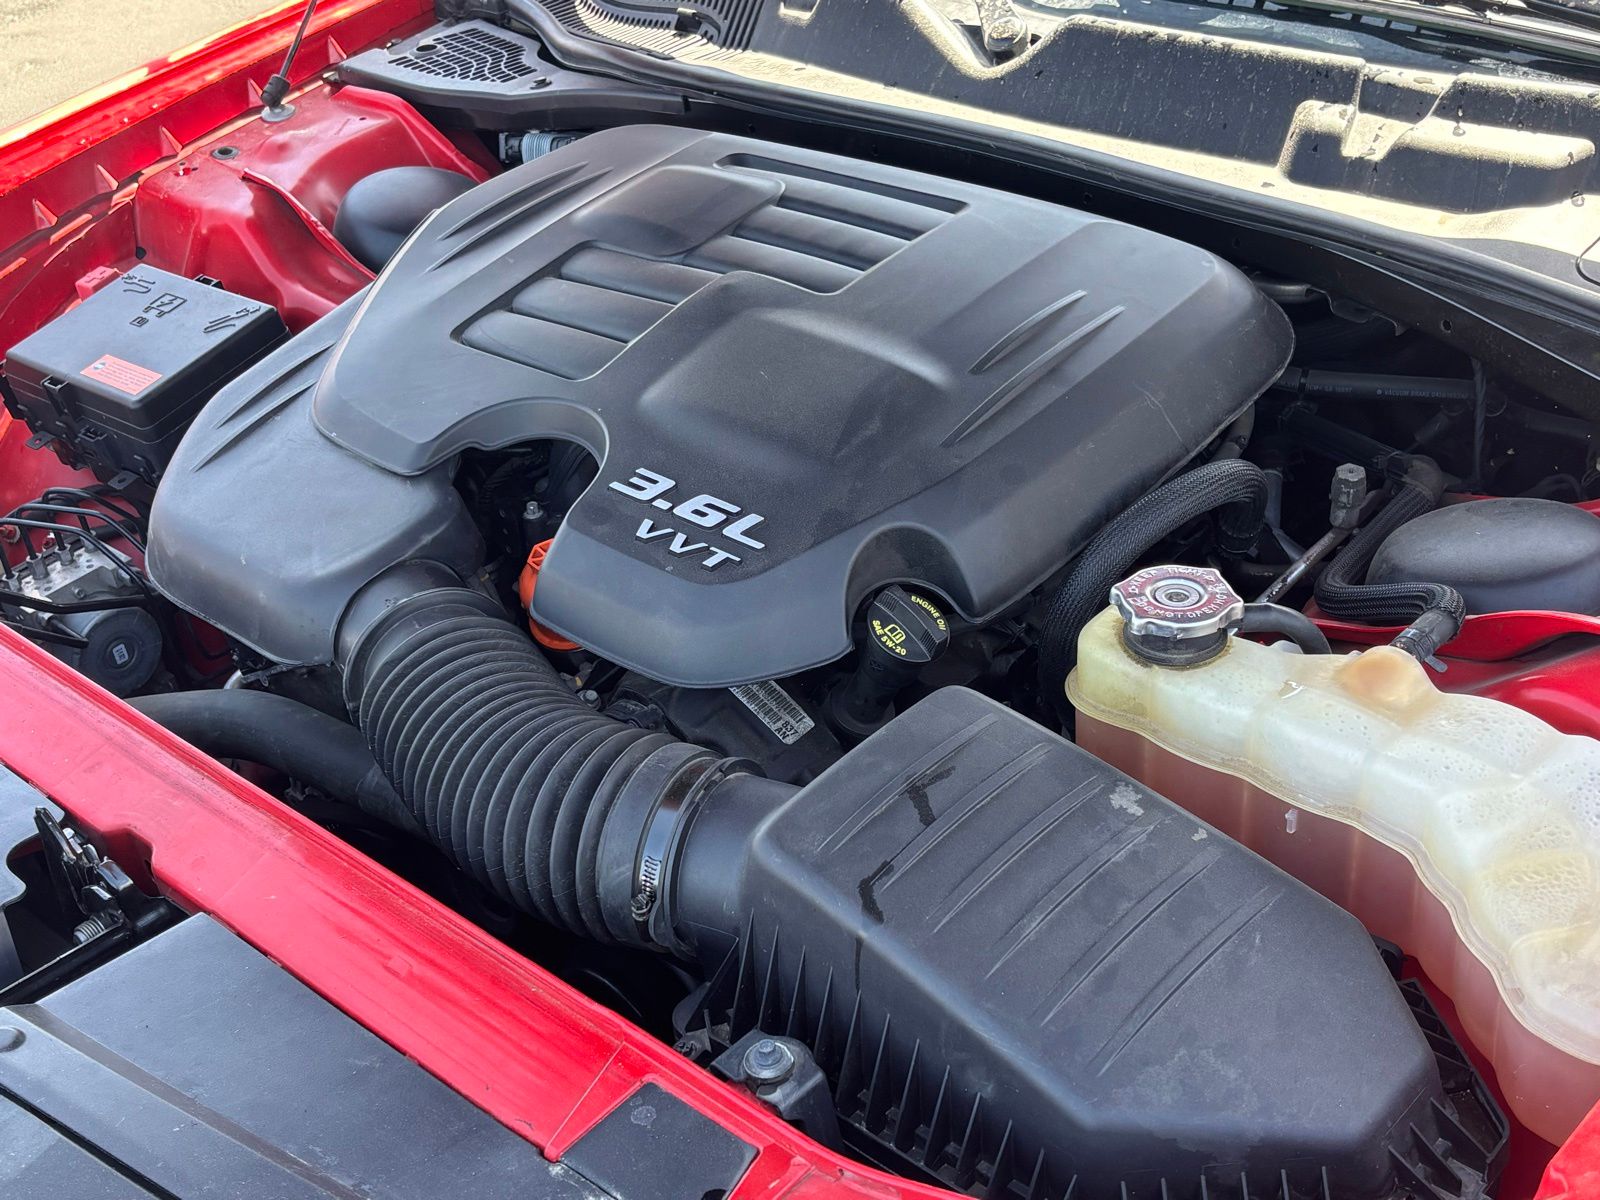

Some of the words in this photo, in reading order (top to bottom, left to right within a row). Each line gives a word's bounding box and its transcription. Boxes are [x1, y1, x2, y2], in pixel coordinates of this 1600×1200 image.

[608, 467, 766, 550] 3.6L
[635, 518, 742, 569] VVT
[911, 595, 940, 619] ENGINE
[872, 620, 884, 636] SAE
[880, 636, 907, 656] 5W-20
[775, 727, 789, 740] AN
[781, 720, 799, 736] 837
